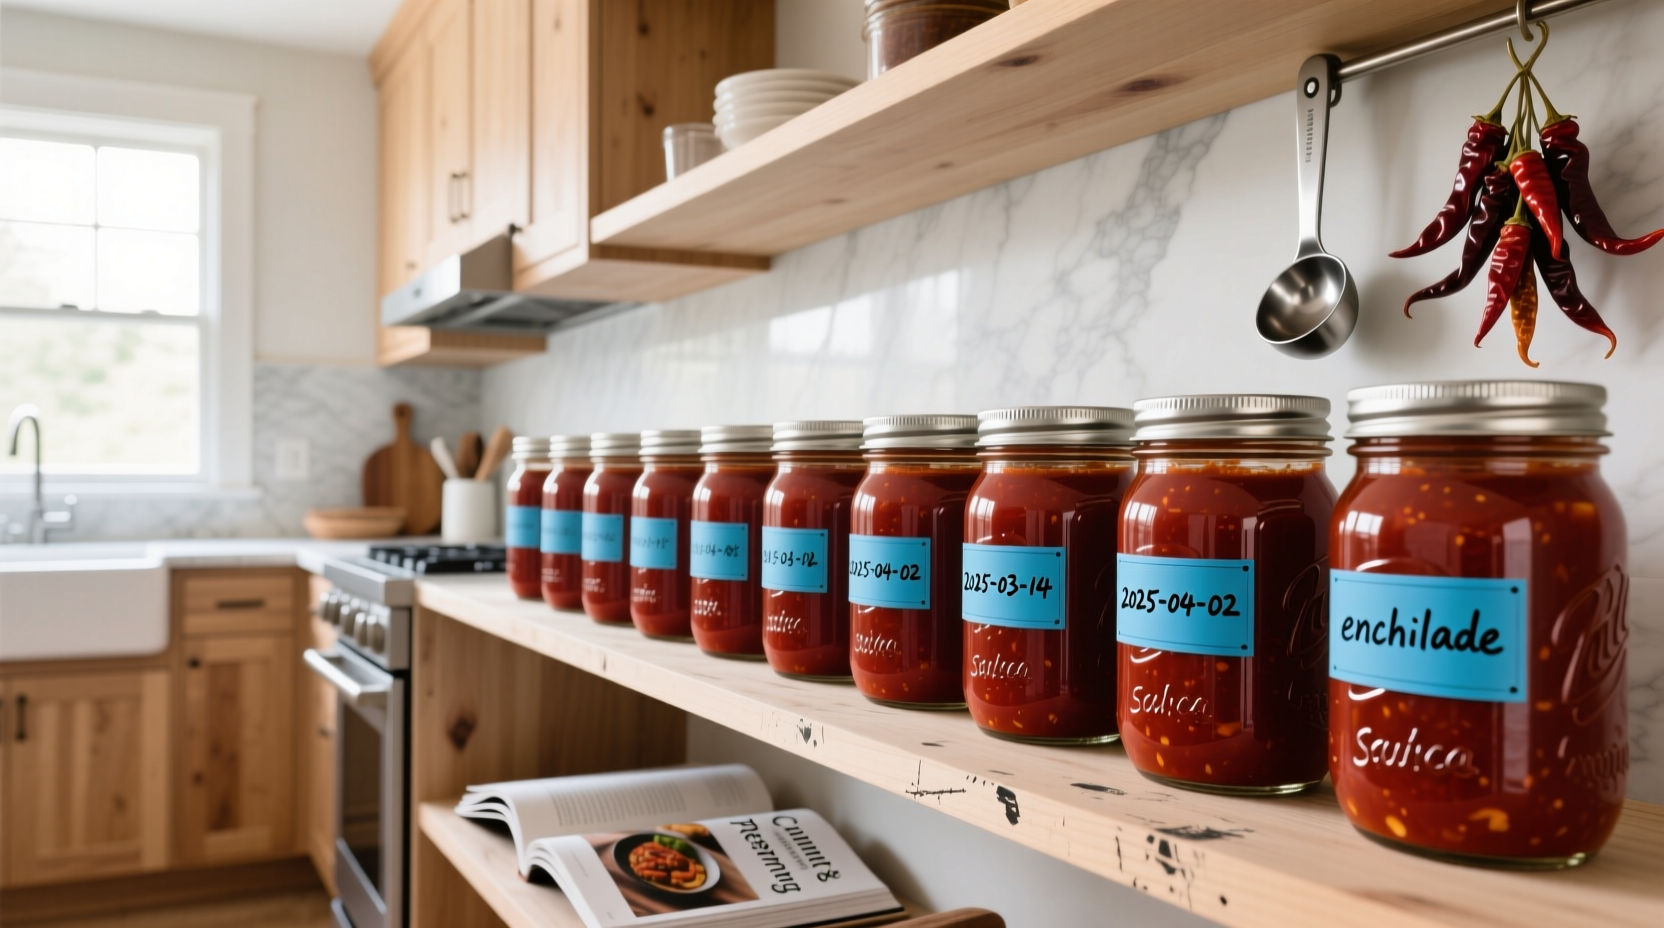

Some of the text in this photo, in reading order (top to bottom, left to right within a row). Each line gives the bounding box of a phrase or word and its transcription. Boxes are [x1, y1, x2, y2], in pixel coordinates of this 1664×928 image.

[963, 571, 1053, 599] 2025-03-14
[1121, 586, 1241, 617] 2025-04-02
[1341, 607, 1504, 656] enchilade
